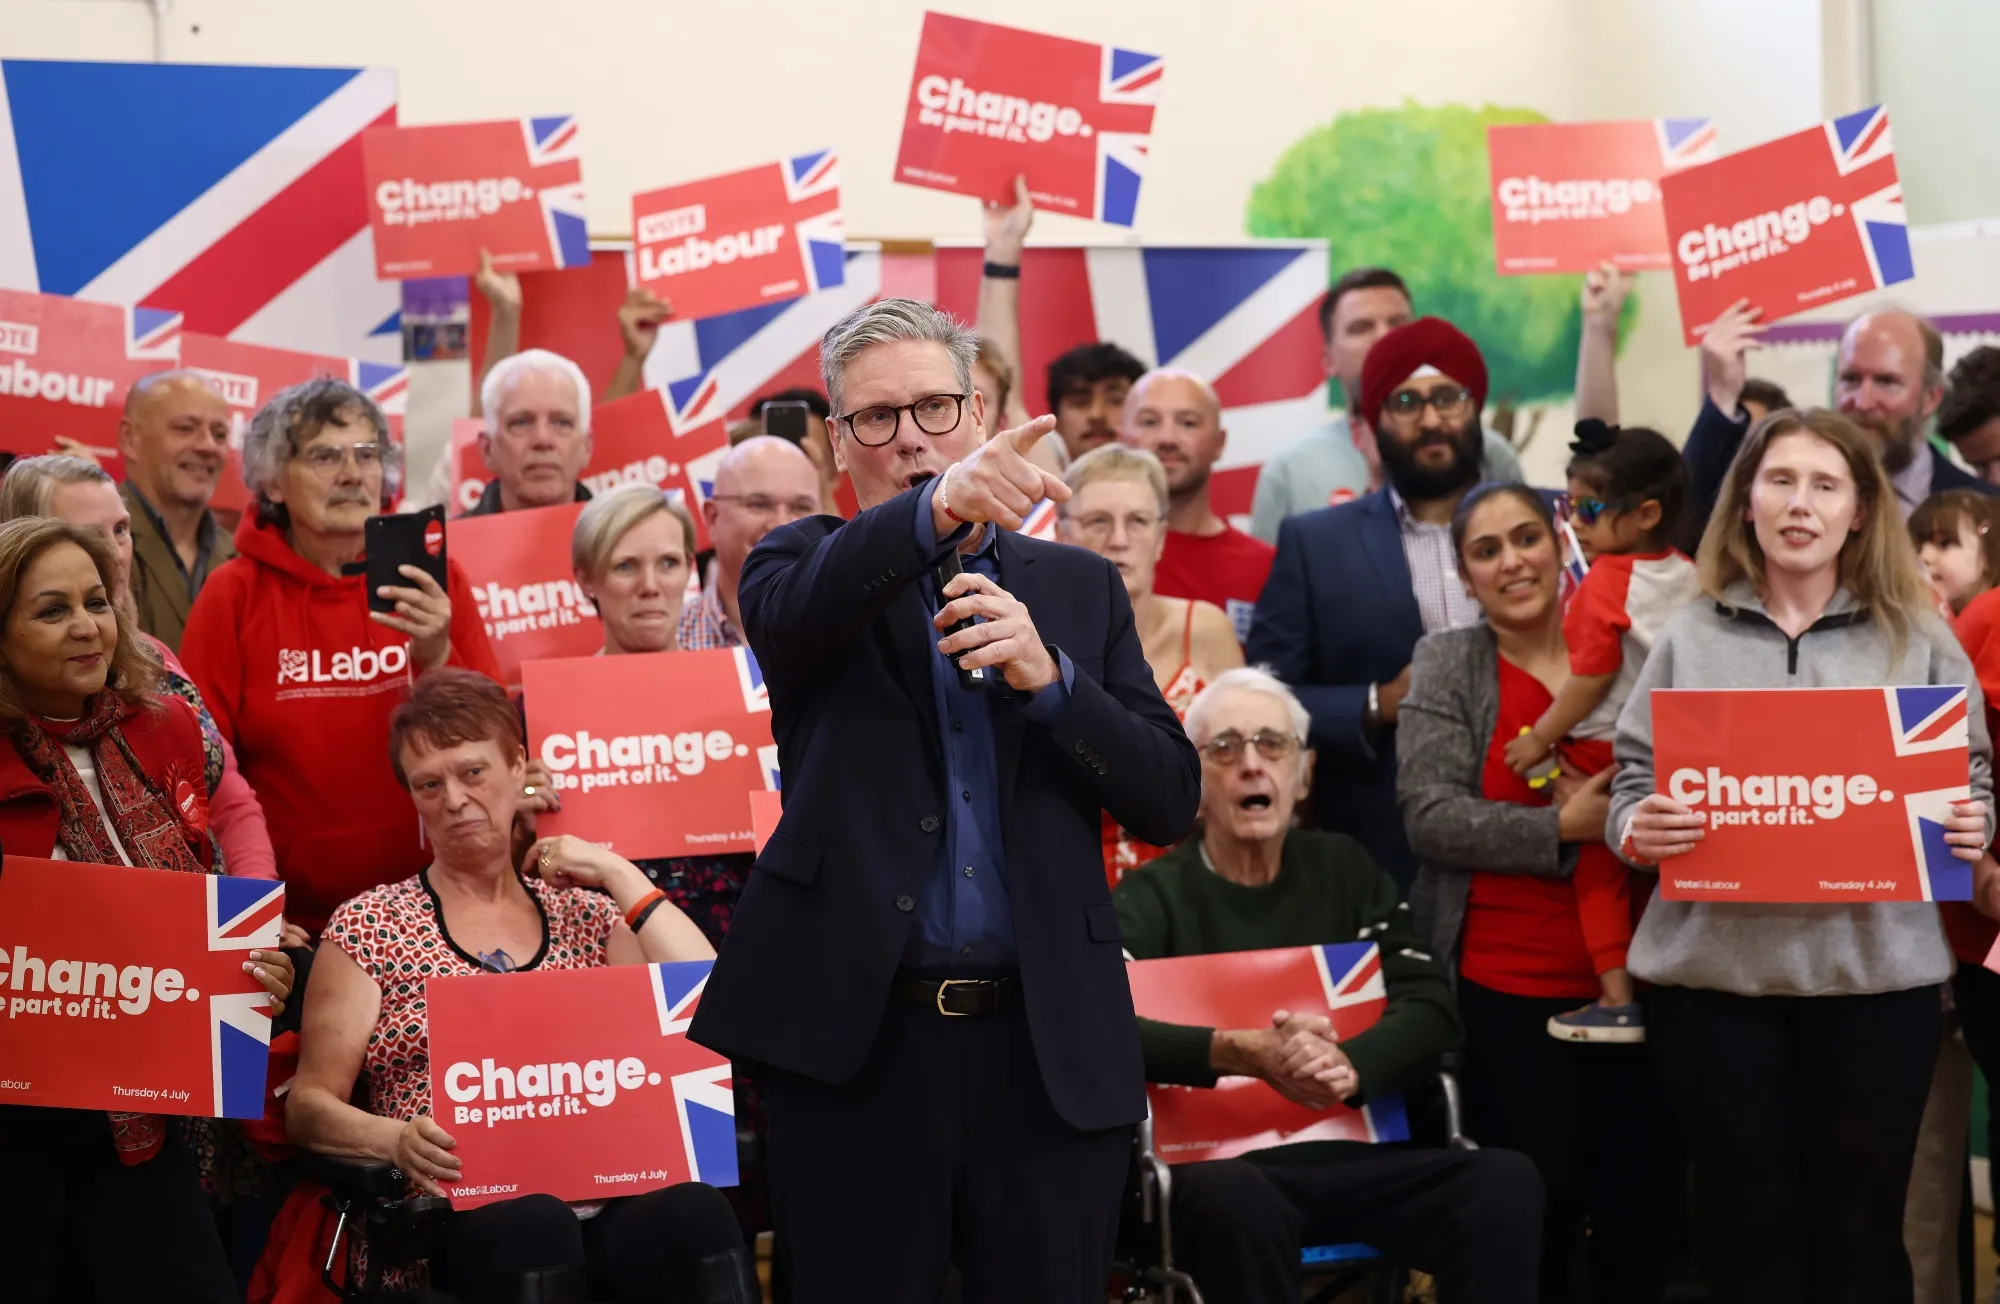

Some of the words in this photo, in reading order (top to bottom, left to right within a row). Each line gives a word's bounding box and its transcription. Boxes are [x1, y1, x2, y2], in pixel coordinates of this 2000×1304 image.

[917, 74, 1093, 142] Change.
[376, 176, 535, 214] Change.
[1499, 175, 1664, 214] Change.
[644, 212, 697, 235] VOTE
[1677, 195, 1845, 266] Change.
[640, 223, 785, 281] Labour
[0, 358, 115, 408] bour
[495, 614, 537, 640] part
[538, 609, 557, 629] of
[559, 607, 580, 626] it.
[312, 645, 408, 682] Labo
[541, 730, 749, 775] Change.
[551, 771, 580, 790] Be
[581, 768, 629, 794] part
[631, 764, 652, 784] of
[655, 764, 678, 783] it.
[1669, 767, 1894, 820] Change.
[1711, 808, 1761, 830] part
[1762, 806, 1787, 826] of
[1789, 806, 1815, 826] it.
[1818, 880, 1866, 892] Thursday
[1867, 880, 1874, 890] 4
[1875, 880, 1897, 892] July
[0, 945, 200, 1015] hange.
[9, 997, 62, 1019] part
[66, 997, 91, 1018] of
[93, 997, 117, 1020] it.
[0, 1079, 31, 1090] abour
[112, 1085, 160, 1101] Thursday
[160, 1088, 168, 1099] 4
[169, 1089, 190, 1103] July
[444, 1056, 662, 1107] Change.
[454, 1106, 483, 1124] Be
[487, 1101, 535, 1128] part
[538, 1096, 561, 1119] of
[564, 1095, 588, 1116] it.
[451, 1186, 477, 1197] Vote
[484, 1184, 518, 1195] Labour
[594, 1172, 638, 1185] Thursday
[639, 1170, 647, 1181] 4
[648, 1169, 668, 1181] July
